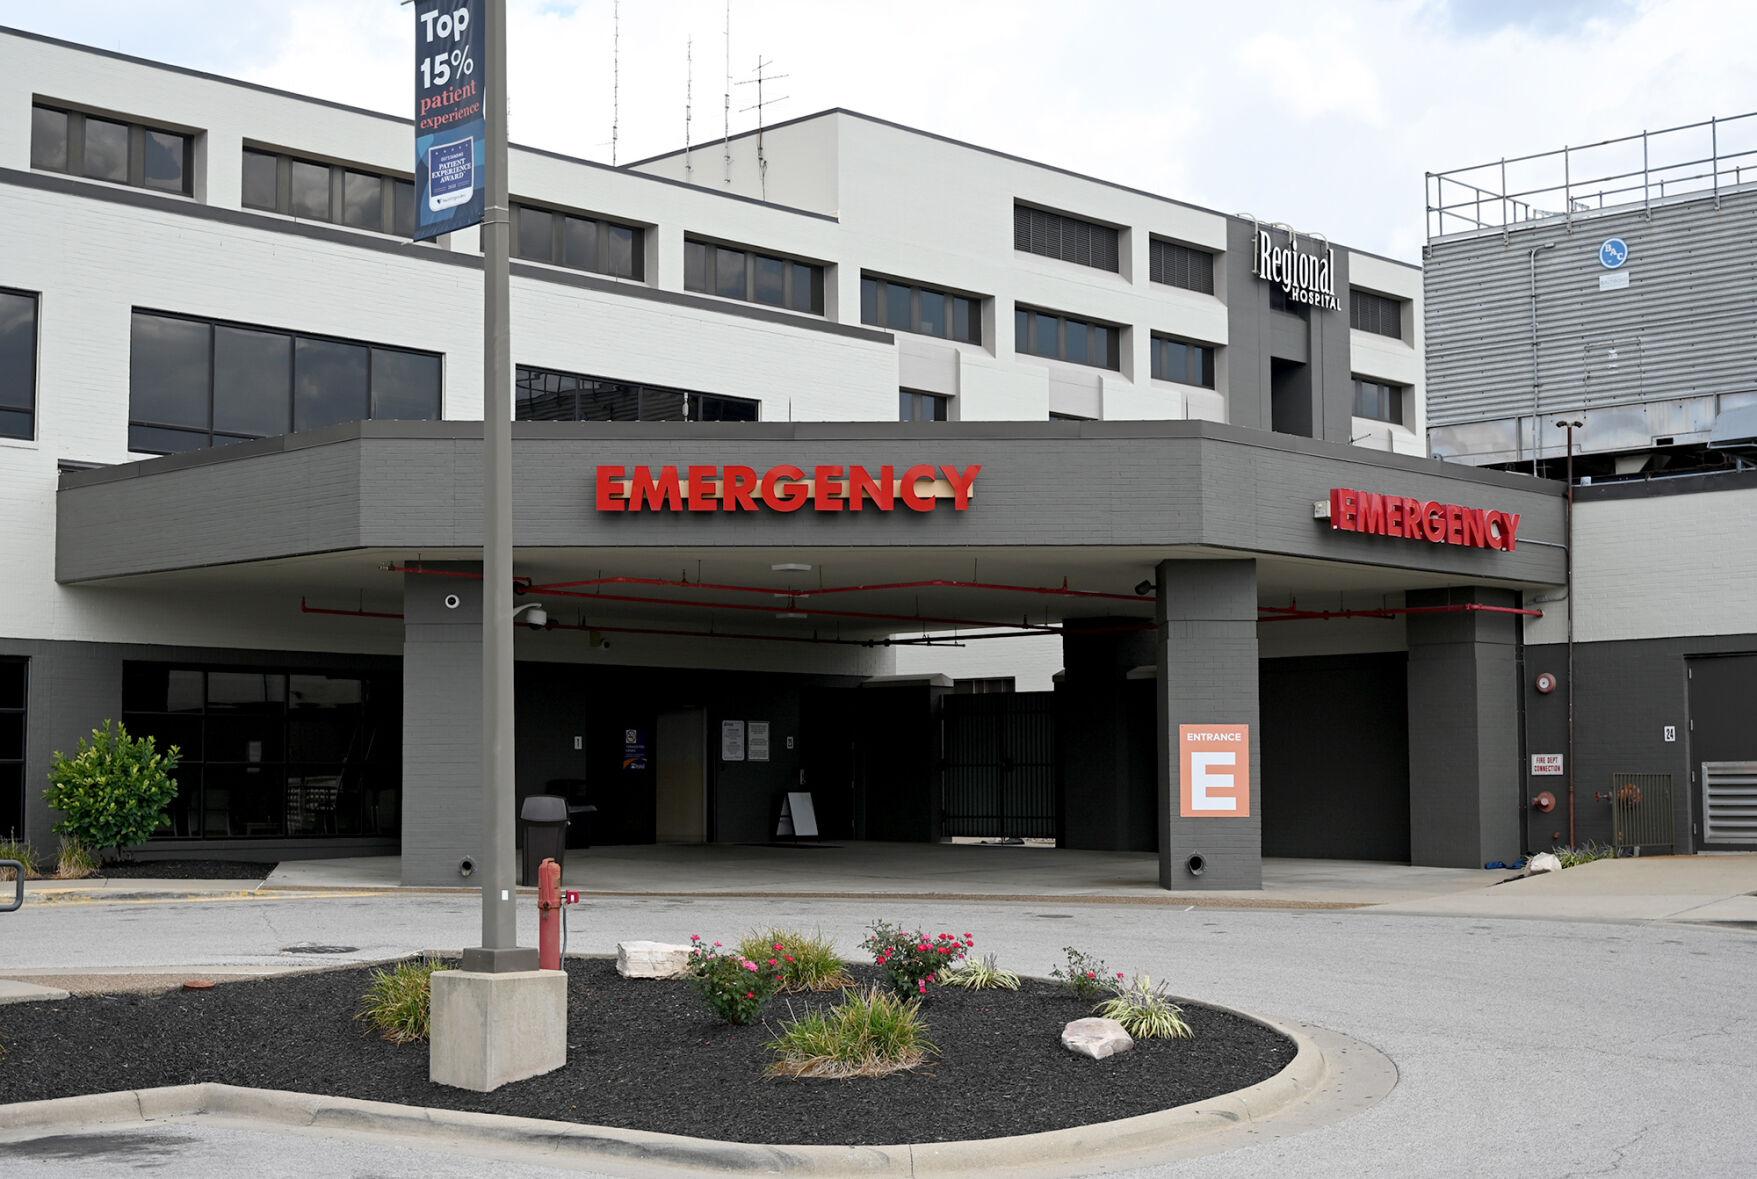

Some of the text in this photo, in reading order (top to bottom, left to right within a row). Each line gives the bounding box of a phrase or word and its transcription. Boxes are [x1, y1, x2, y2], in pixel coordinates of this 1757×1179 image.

[420, 7, 470, 43] Top
[420, 45, 474, 89] 15%
[420, 79, 477, 116] patient
[420, 101, 480, 130] experience
[431, 162, 472, 179] EXPERIENCE
[438, 158, 466, 170] PATIENT
[440, 172, 464, 184] AWARD
[1258, 230, 1335, 295] Regional
[1292, 286, 1342, 311] HOSPITAL
[596, 464, 982, 512] EMERGENCY
[1330, 488, 1521, 552] EMERGENCY
[1187, 732, 1242, 742] ENTRANCE
[1536, 756, 1546, 764] FIRE
[1191, 752, 1237, 810] E
